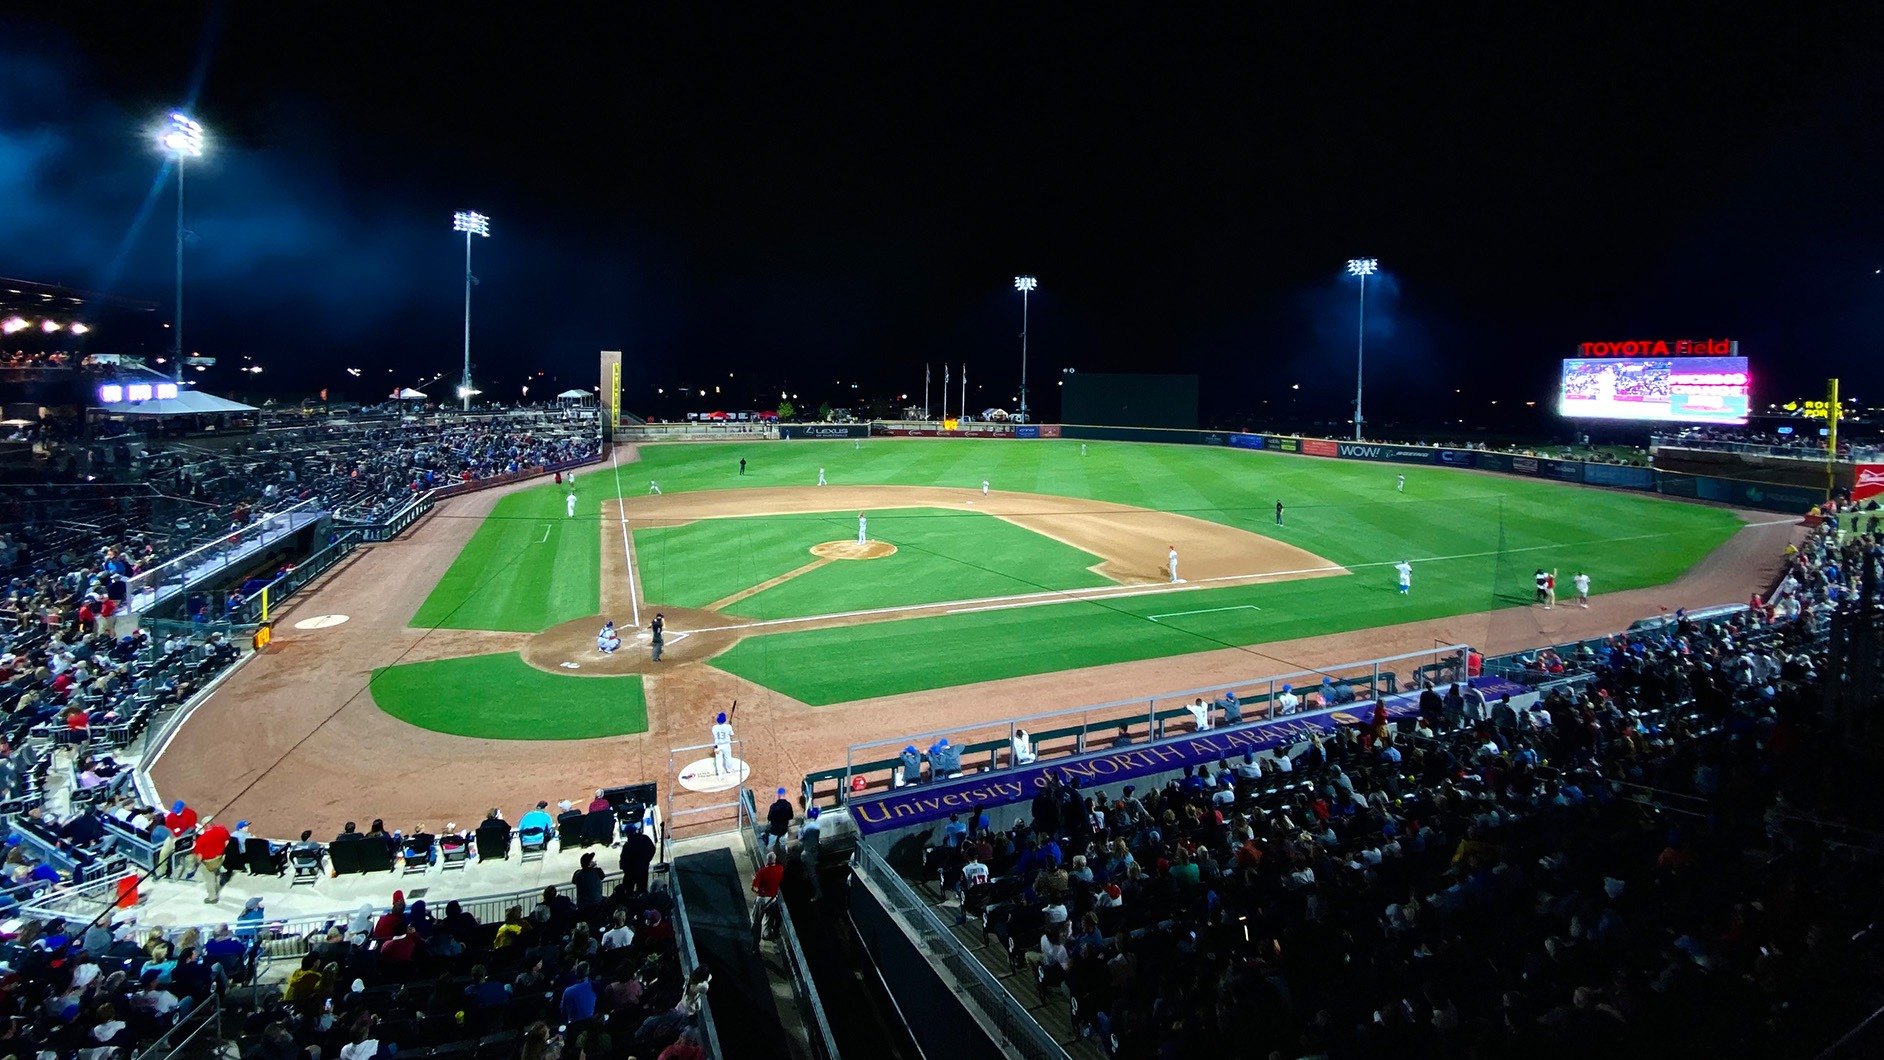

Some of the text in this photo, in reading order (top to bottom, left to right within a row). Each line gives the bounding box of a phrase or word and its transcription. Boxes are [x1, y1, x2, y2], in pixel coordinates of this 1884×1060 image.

[1581, 338, 1729, 356] TOYOTA Field
[1805, 409, 1843, 418] PORH
[1340, 445, 1381, 458] WOW!
[716, 731, 726, 740] 13
[856, 719, 1324, 823] University of NORTH ALABAMA
